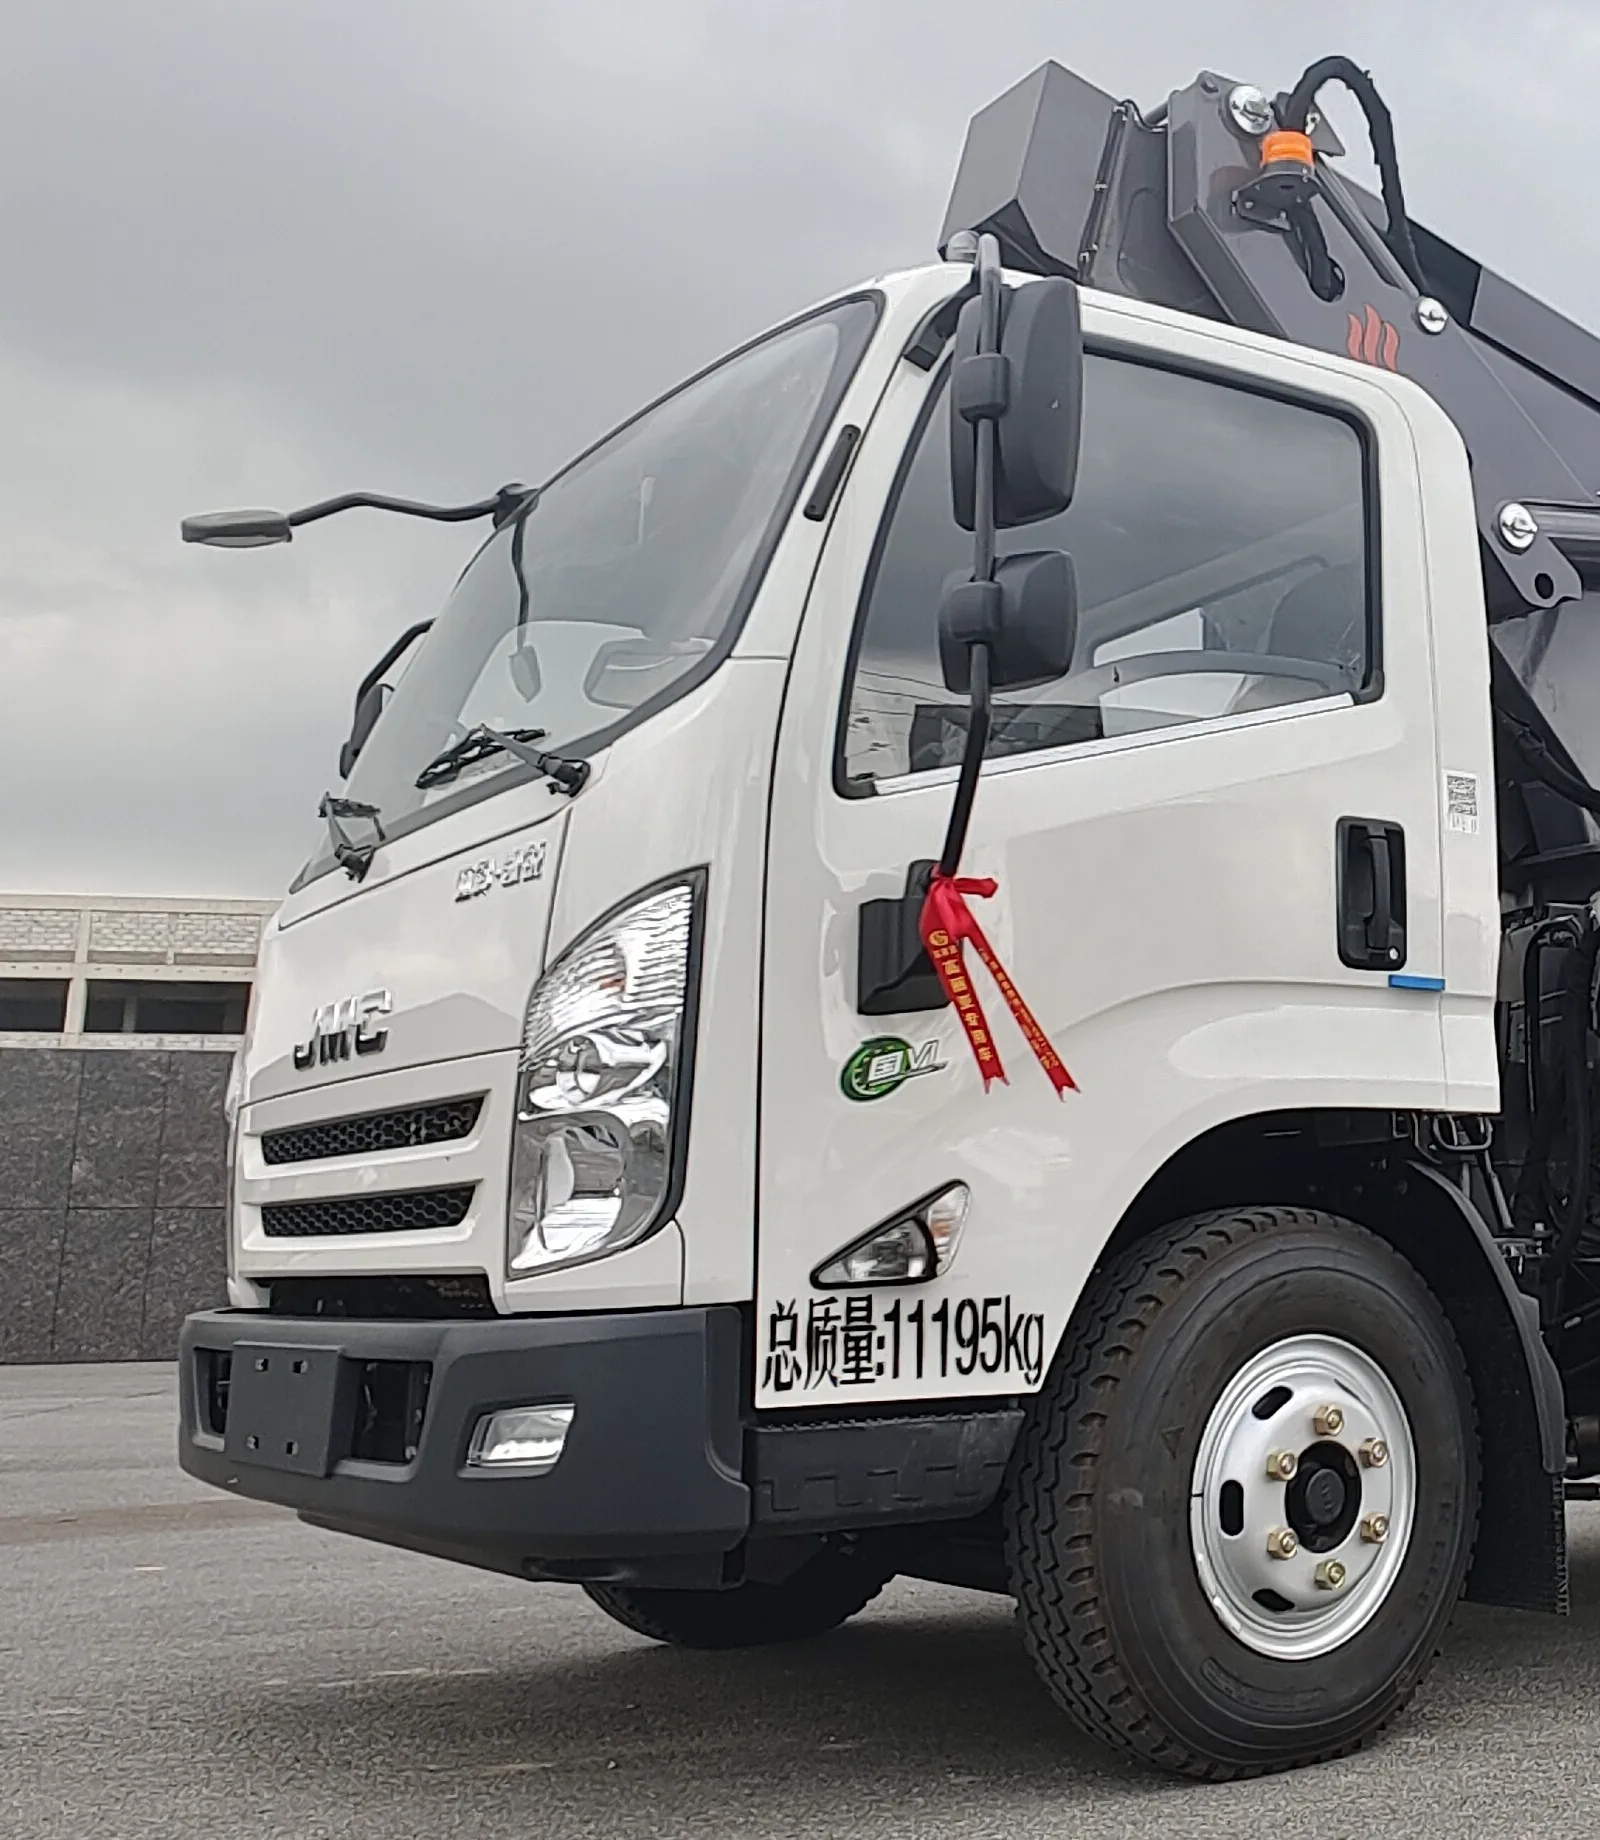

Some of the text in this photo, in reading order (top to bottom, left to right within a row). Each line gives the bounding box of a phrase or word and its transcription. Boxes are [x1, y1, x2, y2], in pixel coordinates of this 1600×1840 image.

[293, 987, 392, 1071] JMC
[762, 1294, 1045, 1391] 总质量:11195kg
